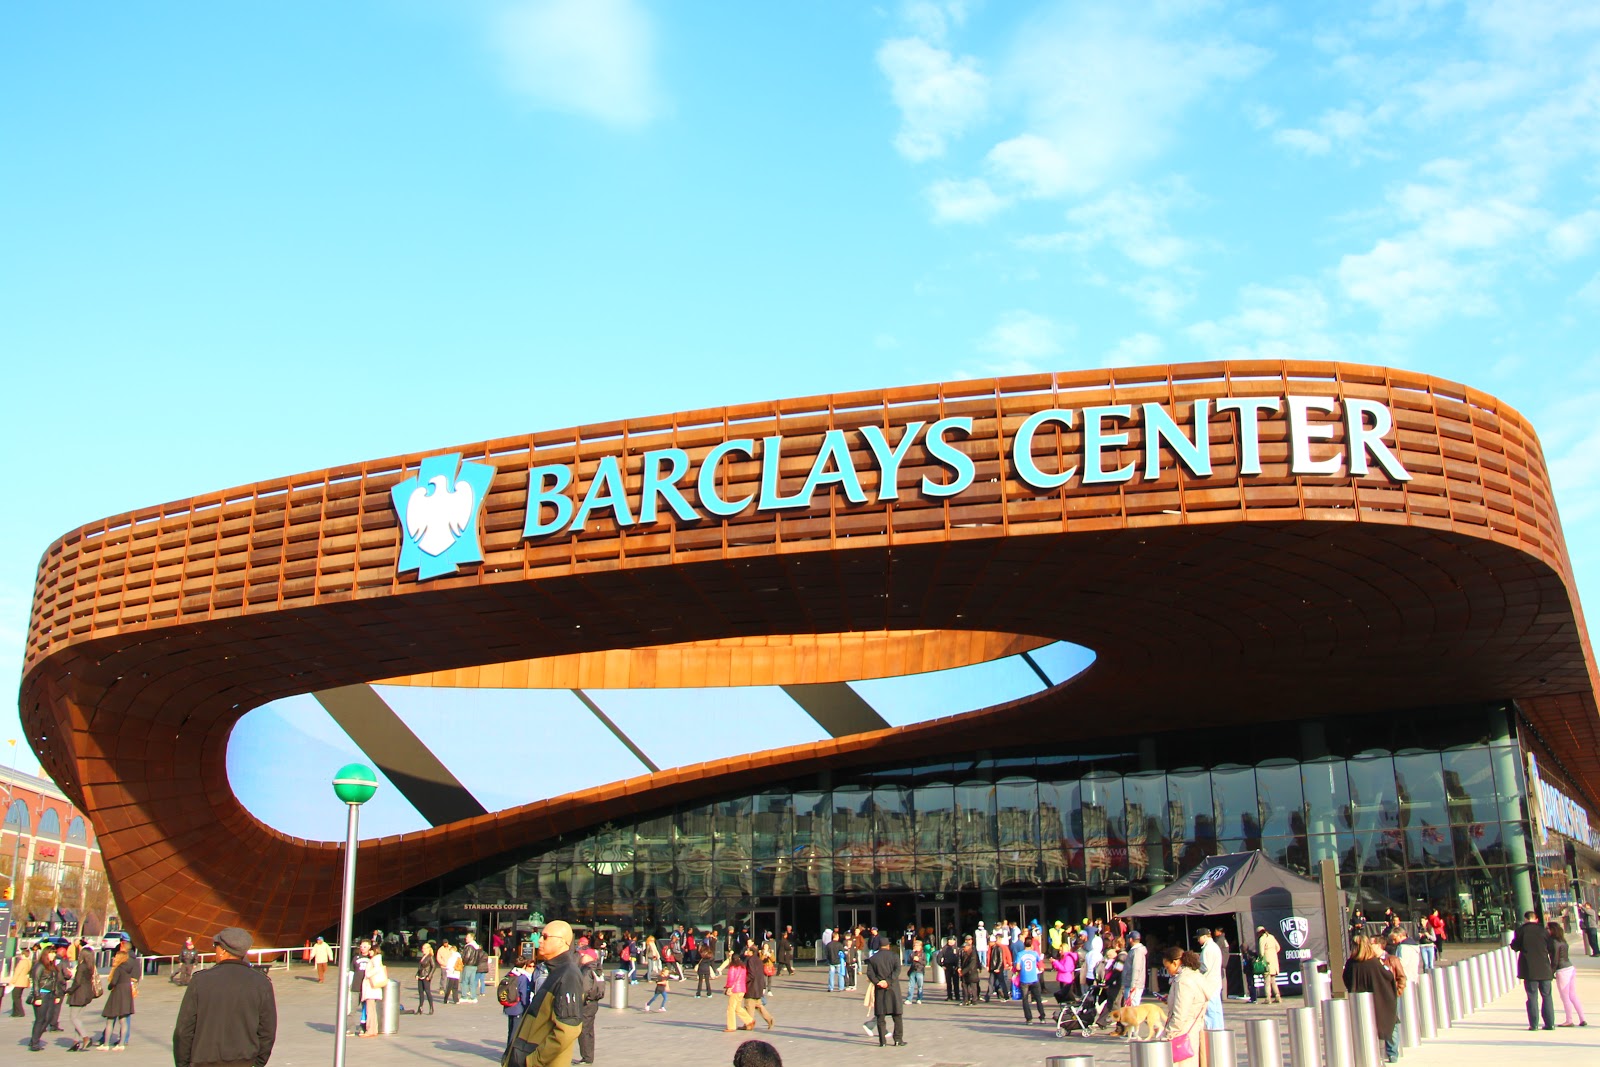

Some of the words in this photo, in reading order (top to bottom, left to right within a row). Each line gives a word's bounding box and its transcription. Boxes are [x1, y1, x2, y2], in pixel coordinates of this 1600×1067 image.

[521, 414, 977, 538] BARCLAYS
[1012, 395, 1414, 489] CENTER
[1281, 919, 1307, 932] NETS
[1285, 949, 1312, 960] BROOKLYN
[1025, 960, 1033, 971] 3
